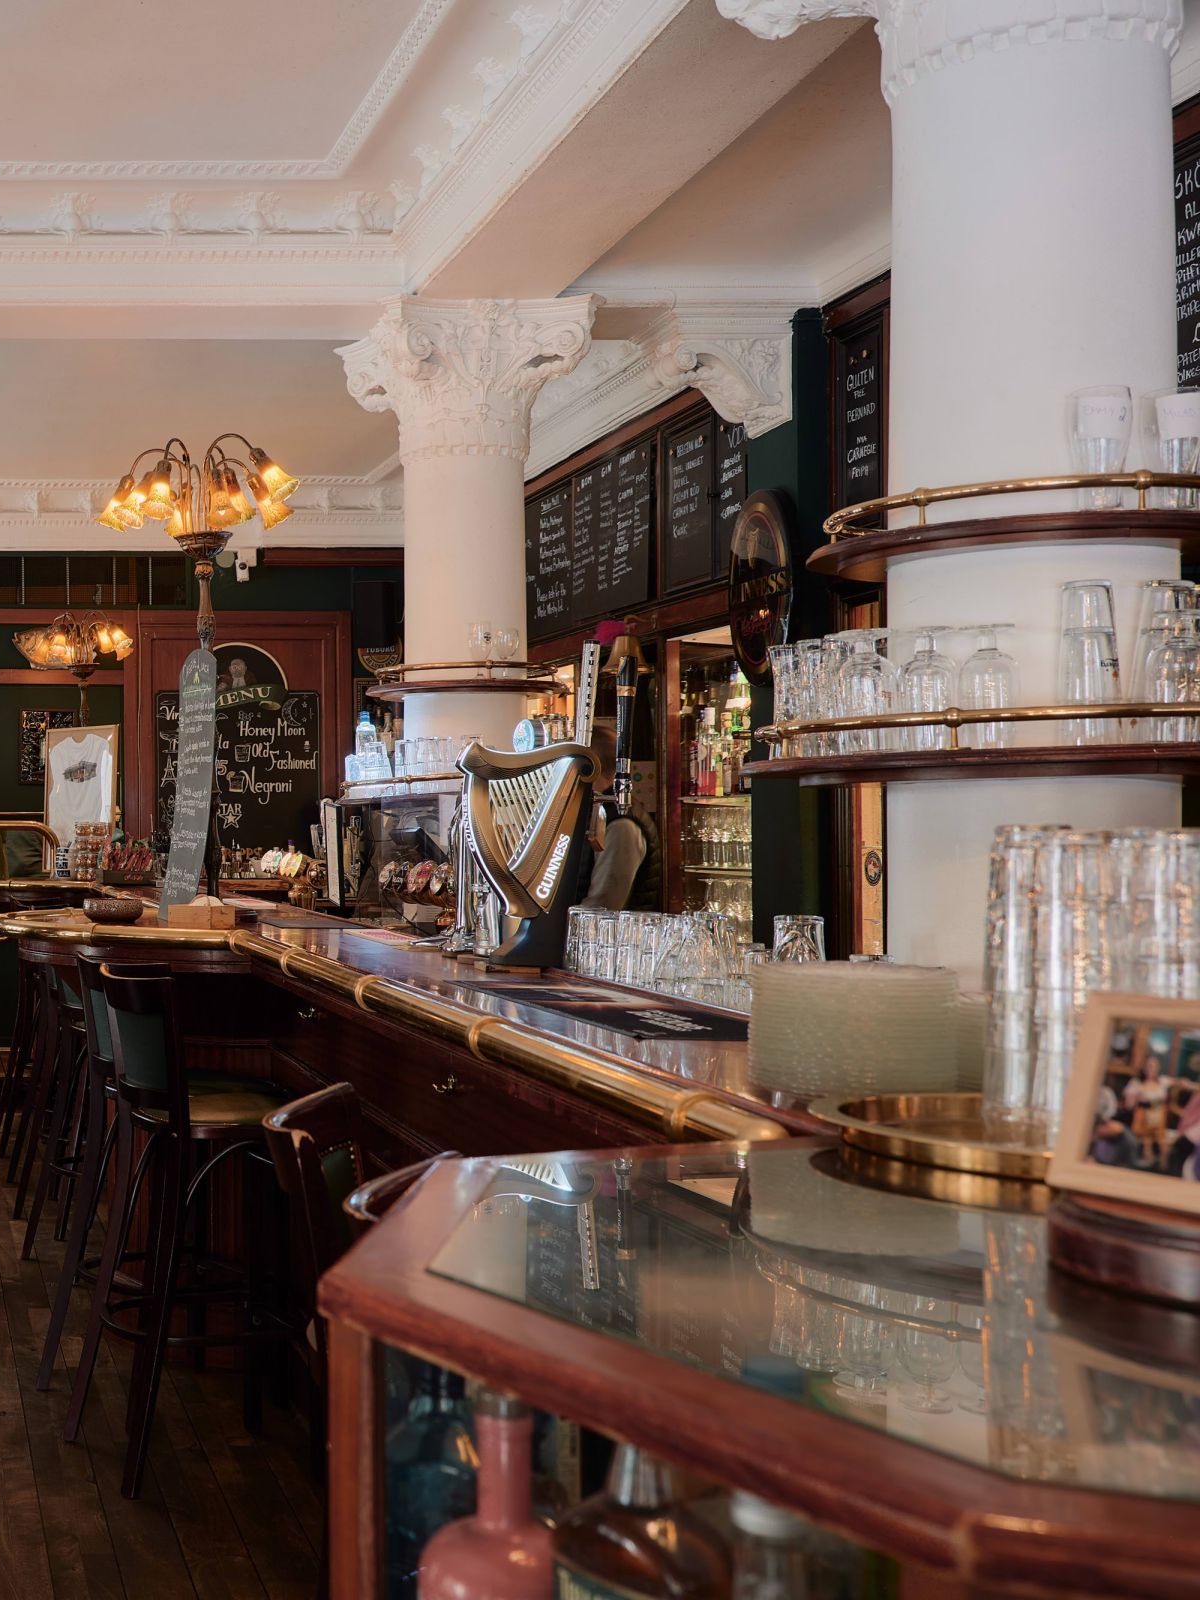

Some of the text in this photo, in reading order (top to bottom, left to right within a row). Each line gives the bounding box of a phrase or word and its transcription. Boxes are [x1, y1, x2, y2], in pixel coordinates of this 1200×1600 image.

[846, 365, 875, 391] GLUTEN
[847, 402, 876, 423] BERNARD
[847, 443, 877, 463] CARNEGIE
[160, 705, 180, 721] Vir
[239, 717, 306, 744] Honey Moon
[251, 741, 318, 771] Old Fashioned
[240, 766, 292, 805] Negroni
[217, 802, 242, 816] TAR
[535, 833, 571, 899] GUINNESS
